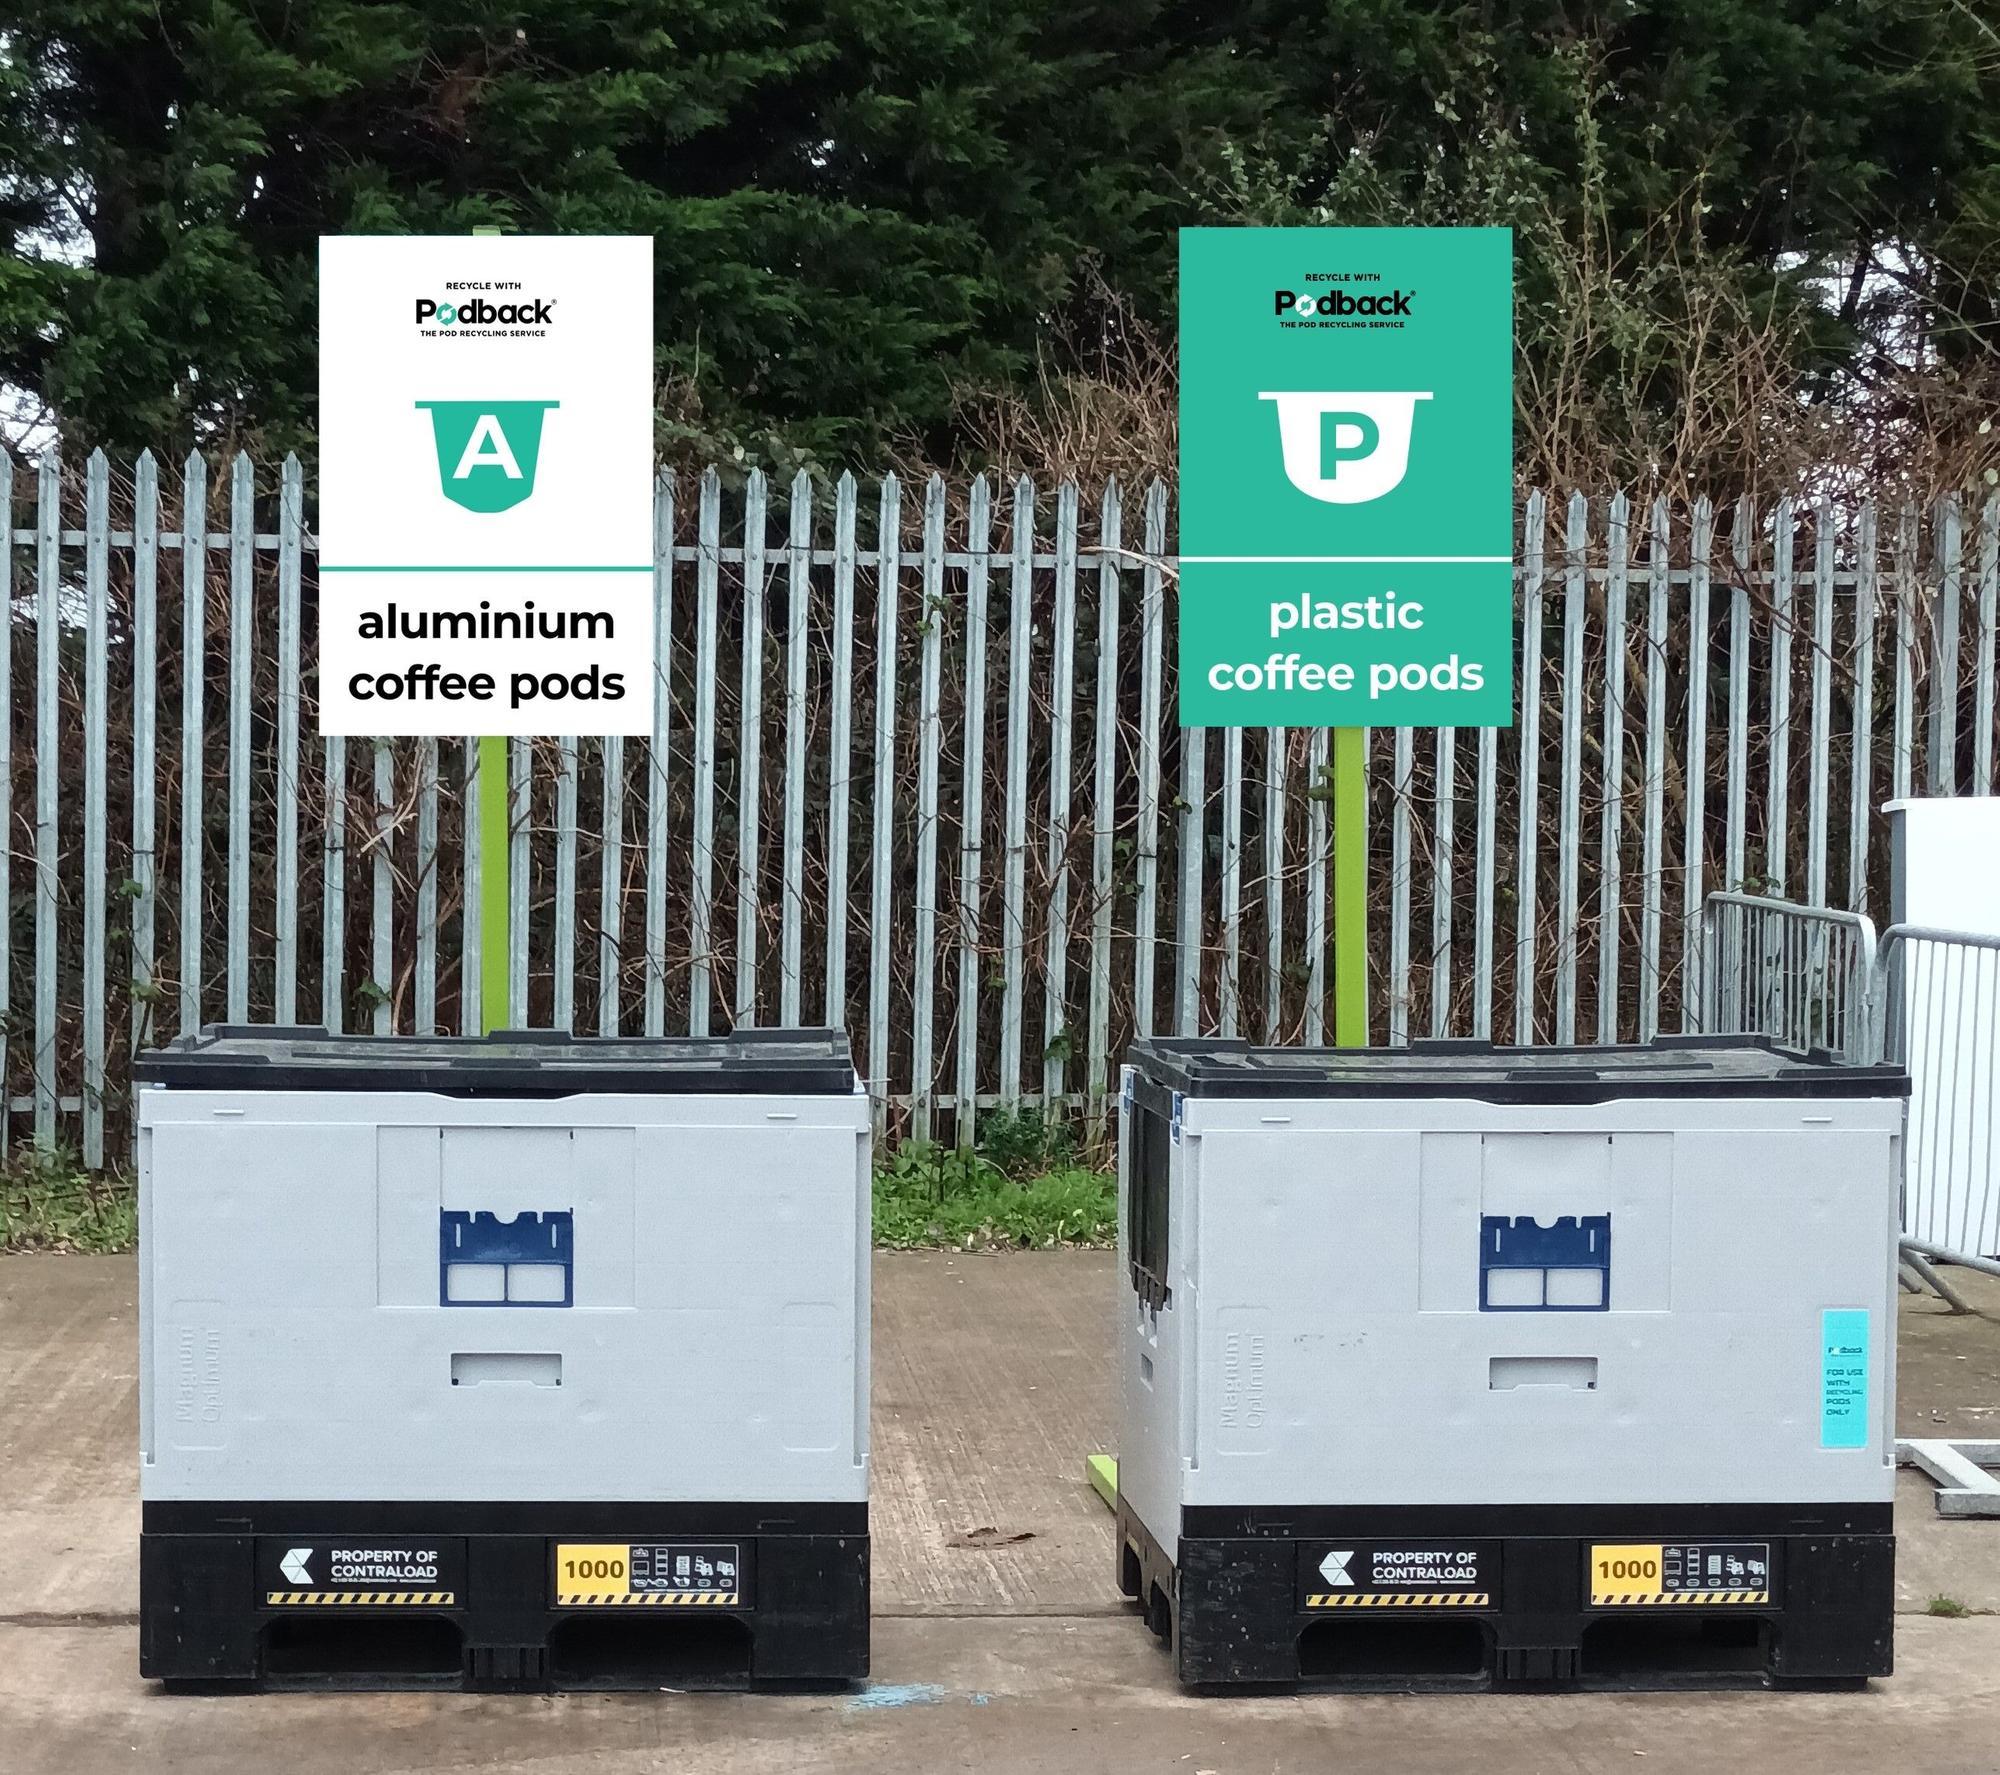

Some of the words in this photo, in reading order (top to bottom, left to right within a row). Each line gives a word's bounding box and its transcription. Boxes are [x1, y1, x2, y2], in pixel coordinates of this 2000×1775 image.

[1305, 273, 1350, 281] RECYCLE
[1353, 273, 1380, 281] WITH
[446, 282, 491, 290] RECYCLE
[494, 282, 521, 290] WITH
[453, 414, 523, 479] A
[1320, 412, 1379, 480] P
[358, 601, 614, 639] aluminium
[1270, 591, 1424, 638] plastic
[1208, 653, 1354, 691] coffee
[1370, 654, 1484, 699] pods
[349, 664, 496, 700] coffee
[511, 664, 625, 709] pods
[331, 1550, 412, 1562] PROPERTY
[416, 1550, 438, 1562] OF
[1372, 1552, 1453, 1564] PROPERTY
[1456, 1552, 1477, 1564] OF
[331, 1565, 438, 1577] CONTRALOAD
[565, 1560, 624, 1578] 1000
[1372, 1567, 1477, 1579] CONTRALOAD
[1599, 1561, 1657, 1578] 1000
